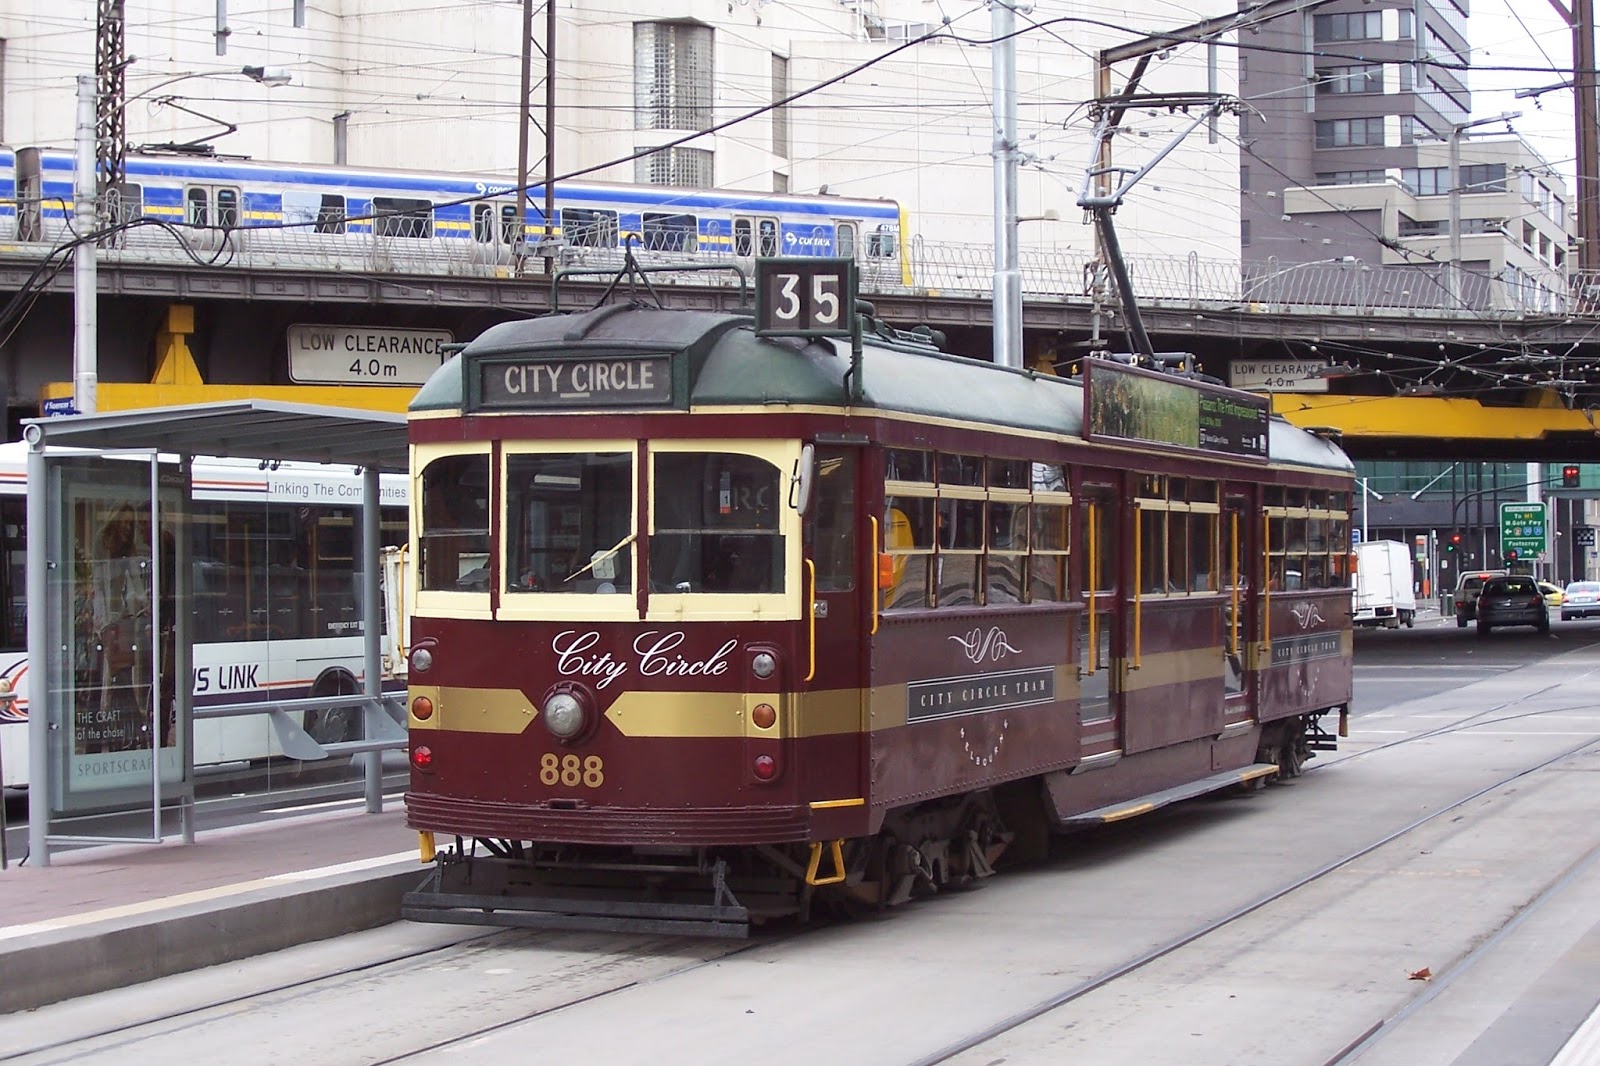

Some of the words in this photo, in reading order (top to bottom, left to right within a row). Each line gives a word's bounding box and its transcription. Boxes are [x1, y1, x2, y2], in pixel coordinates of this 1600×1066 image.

[775, 273, 840, 324] 35
[300, 334, 335, 351] LOW
[345, 334, 444, 355] CLEARANCE
[504, 364, 563, 394] CITY
[571, 361, 654, 392] CIRCLE
[1234, 364, 1256, 374] LOW
[267, 481, 309, 498] Linking
[313, 483, 334, 496] The
[552, 630, 628, 690] City
[633, 630, 738, 676] Circle
[218, 664, 259, 690] LINK
[921, 692, 952, 707] CITY
[962, 684, 1007, 701] CIRCLE
[1016, 679, 1046, 694] TRAM
[77, 711, 93, 724] THE
[96, 709, 121, 723] CRAFT
[77, 727, 86, 740] of
[88, 727, 100, 739] the
[77, 757, 158, 777] SPORTSCRAF
[539, 753, 604, 788] 888
